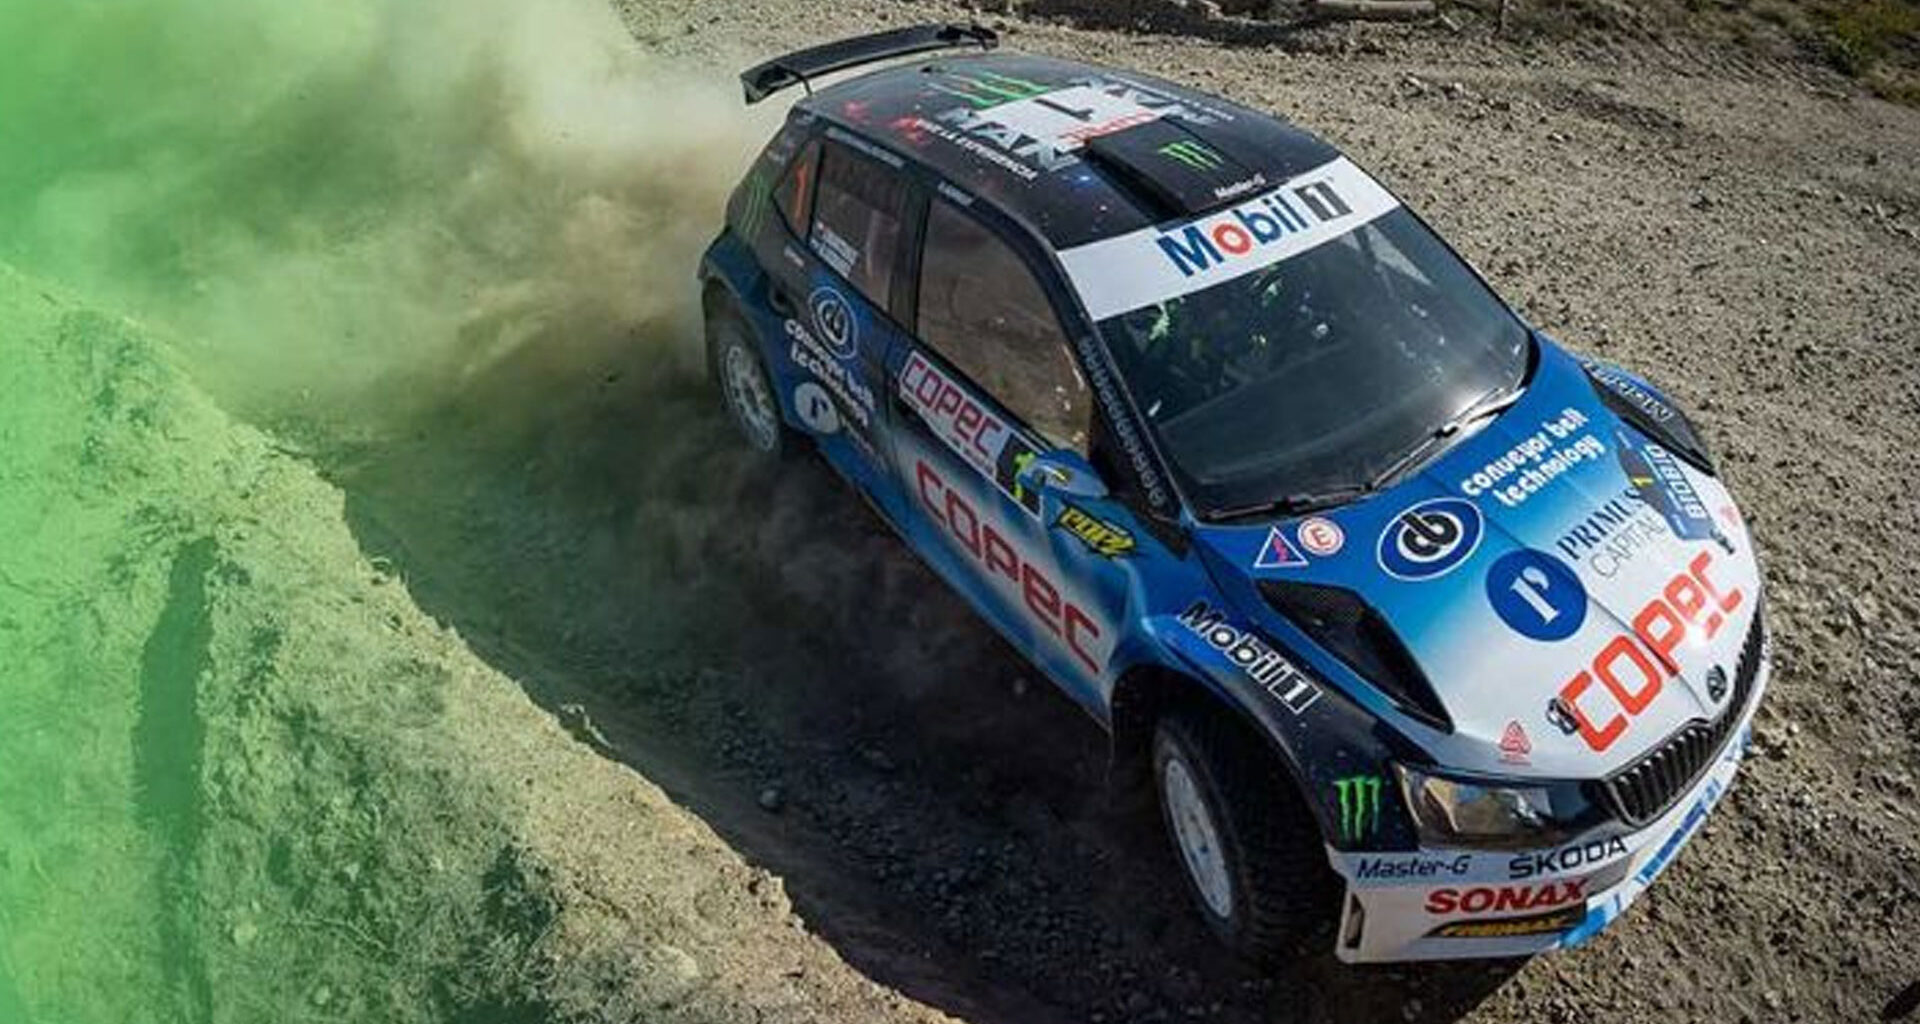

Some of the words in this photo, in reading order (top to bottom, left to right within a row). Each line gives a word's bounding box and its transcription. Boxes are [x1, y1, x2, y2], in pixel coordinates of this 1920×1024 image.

[1156, 194, 1310, 277] Mobil
[1461, 431, 1553, 496] conveyor
[1541, 407, 1590, 439] belt
[1491, 434, 1606, 507] technology
[1176, 600, 1290, 684] Mobil
[1356, 854, 1473, 880] Master-G
[1424, 876, 1590, 915] SONAX
